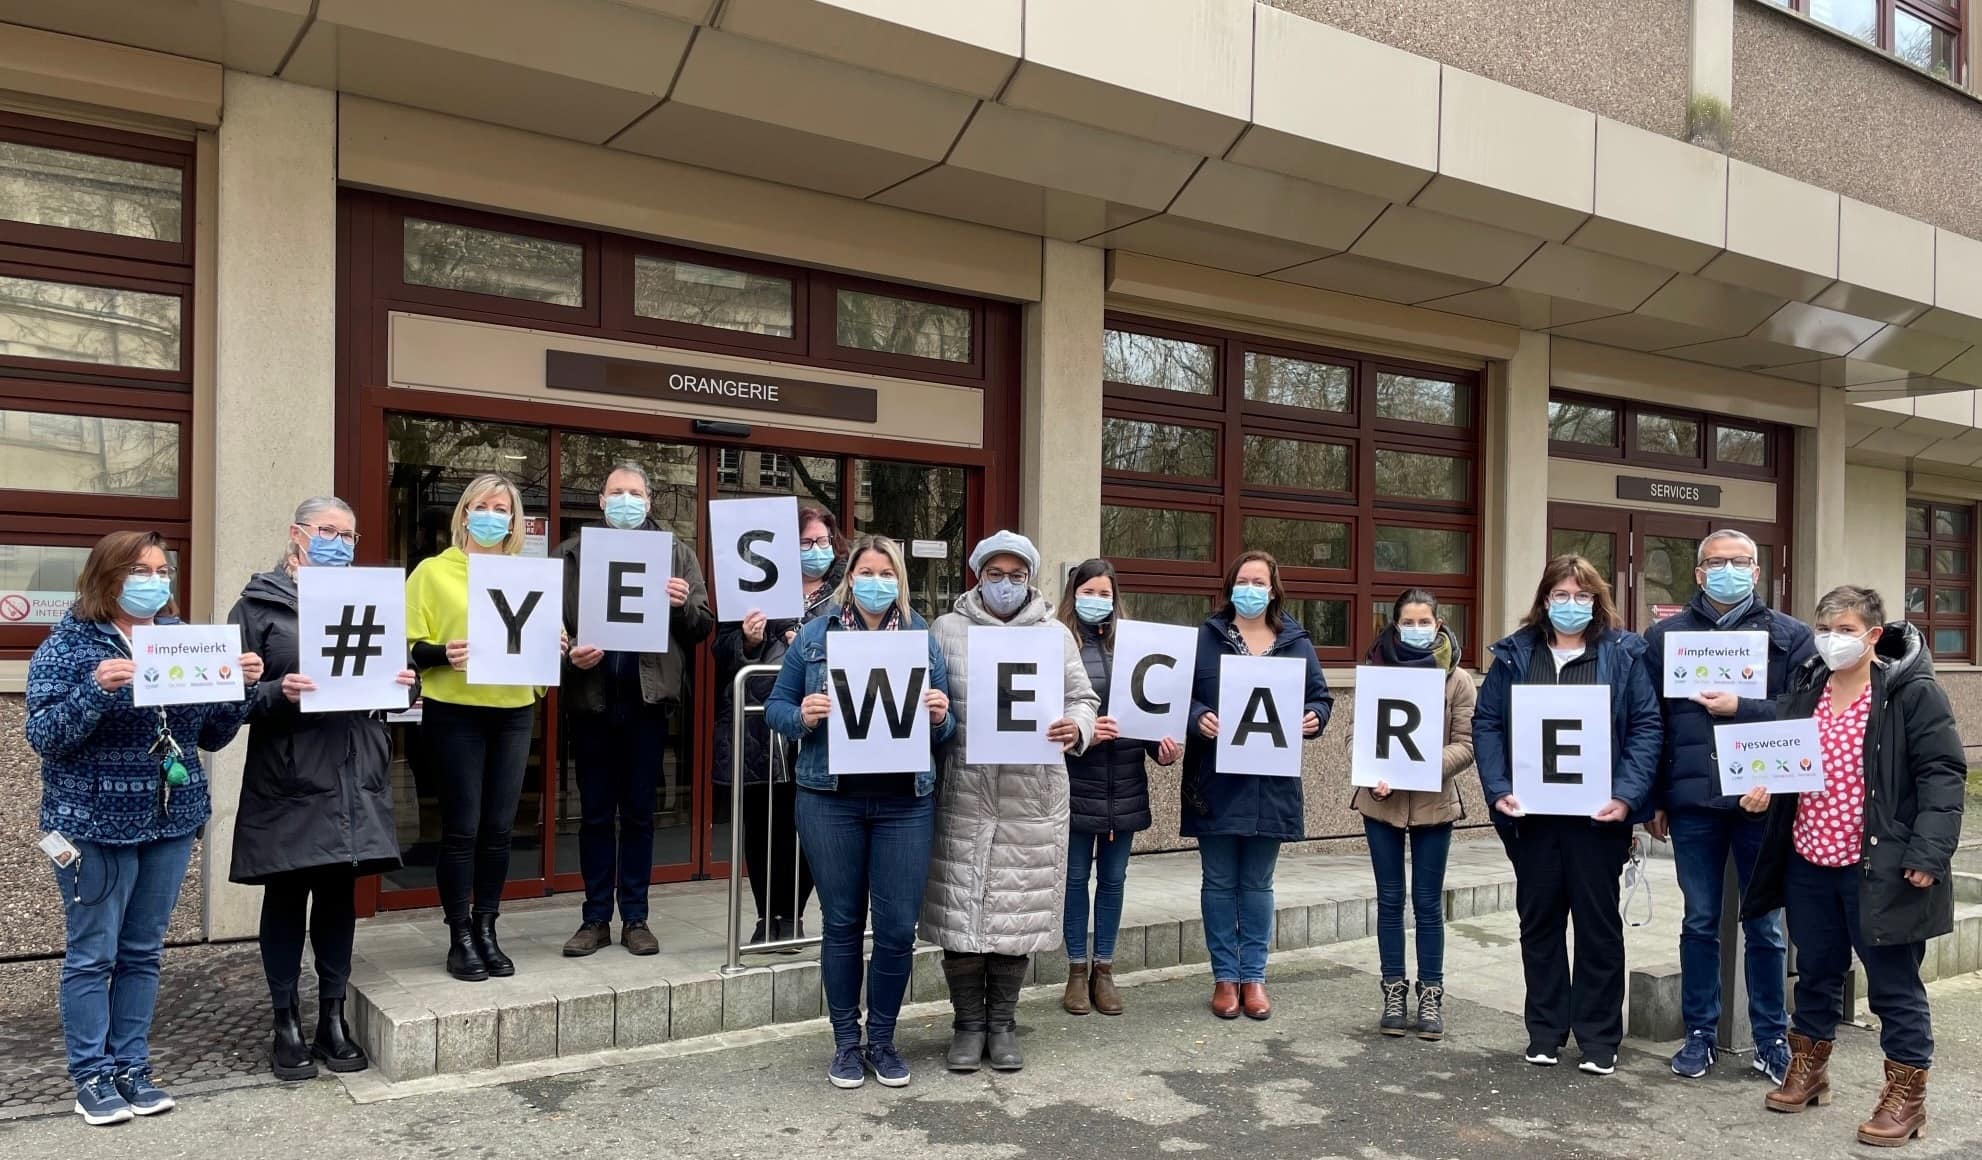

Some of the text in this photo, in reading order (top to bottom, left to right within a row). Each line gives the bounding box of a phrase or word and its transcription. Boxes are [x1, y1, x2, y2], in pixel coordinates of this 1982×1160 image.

[668, 374, 779, 402] ORANGERIE
[1650, 483, 1700, 501] SERVICES
[606, 561, 647, 624] E
[736, 529, 779, 593] S
[146, 642, 227, 656] #impfewierkt
[486, 588, 544, 655] Y
[1677, 647, 1750, 658] #impfewierkt
[830, 666, 927, 740] W
[996, 662, 1038, 732] E
[1130, 653, 1177, 715] C
[1230, 686, 1289, 749] A
[1375, 698, 1426, 762] R
[1735, 738, 1801, 752] #yeswecare
[1541, 718, 1583, 785] E
